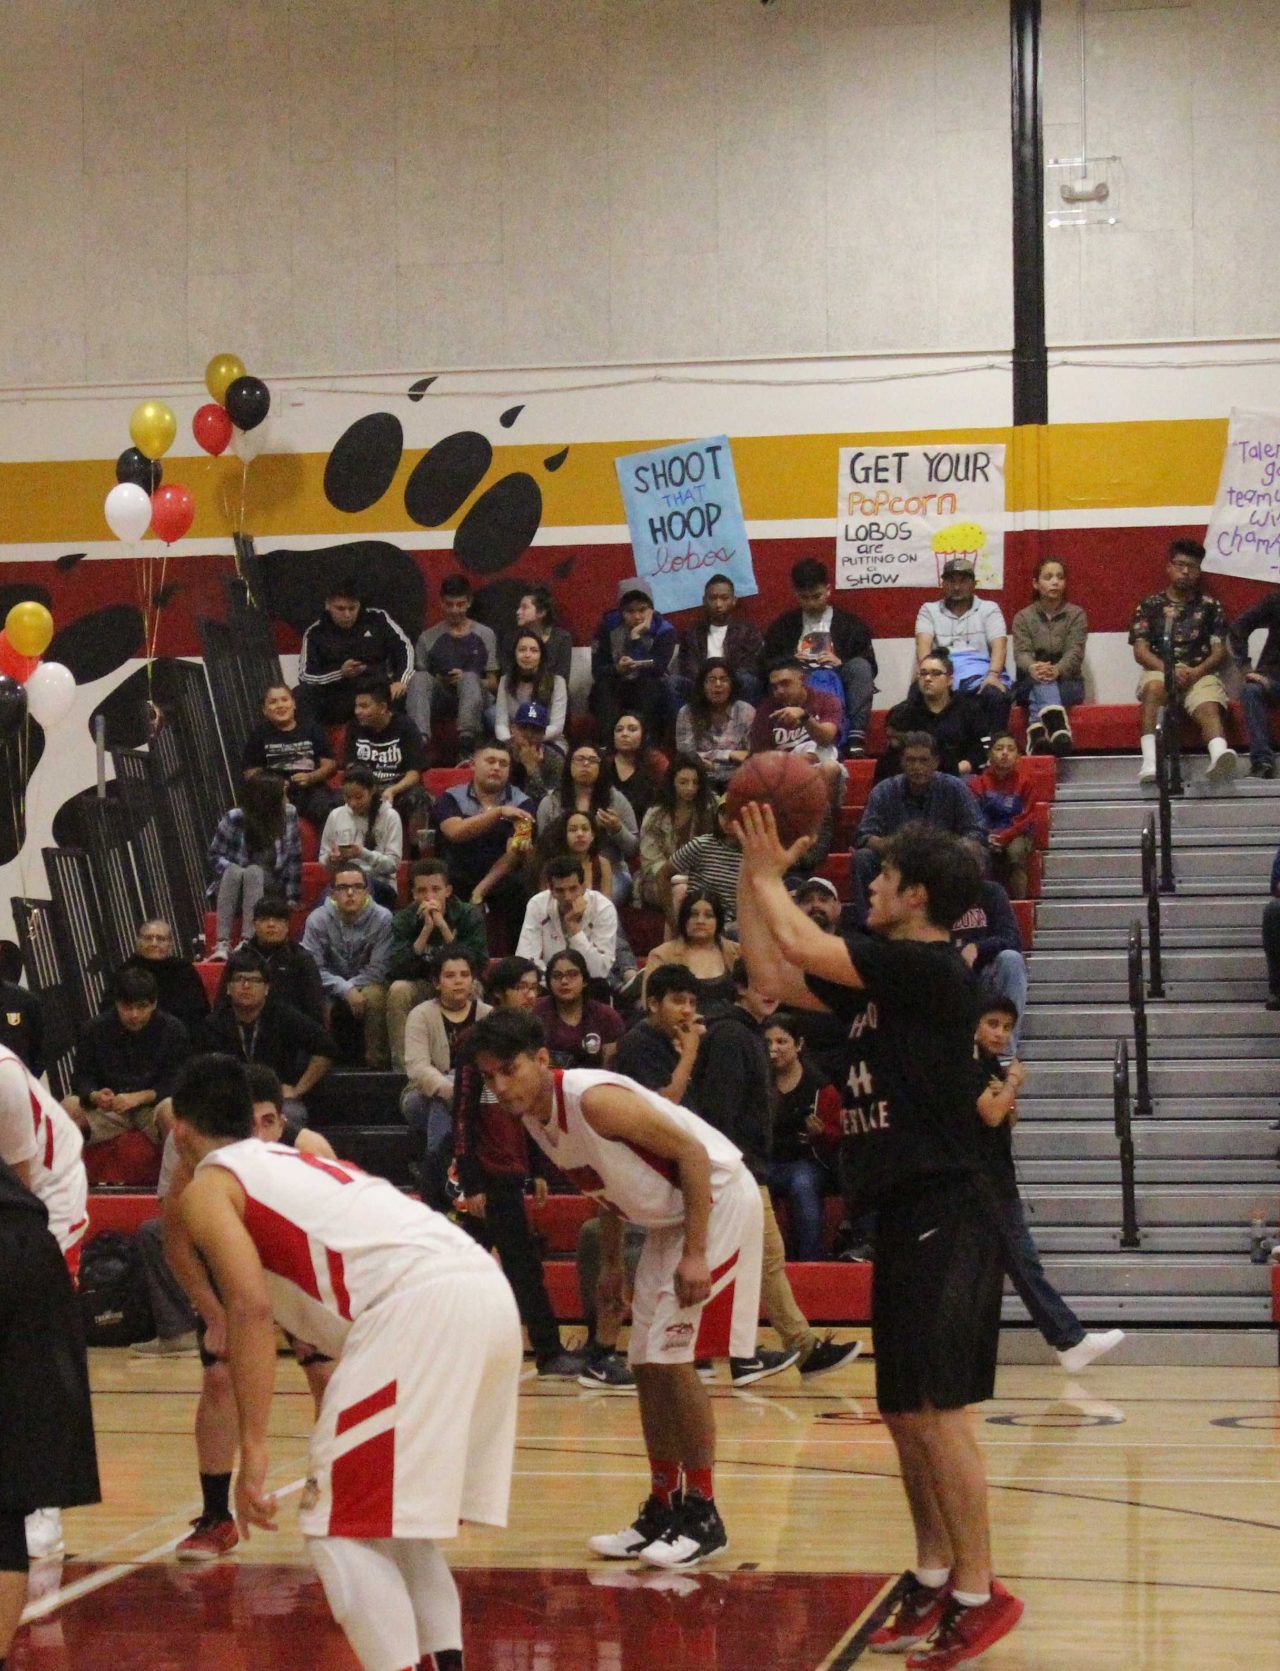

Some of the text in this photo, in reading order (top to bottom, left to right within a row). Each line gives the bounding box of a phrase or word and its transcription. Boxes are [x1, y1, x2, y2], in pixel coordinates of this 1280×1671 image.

[634, 445, 722, 494] SHOOT
[849, 451, 991, 484] GET YOUR
[662, 484, 706, 508] THAT
[648, 503, 722, 545] HOOP
[845, 522, 912, 542] LOBOS
[842, 553, 918, 567] PUTTING ON
[857, 543, 883, 554] are
[846, 573, 899, 587] SHOW
[355, 742, 402, 765] Death
